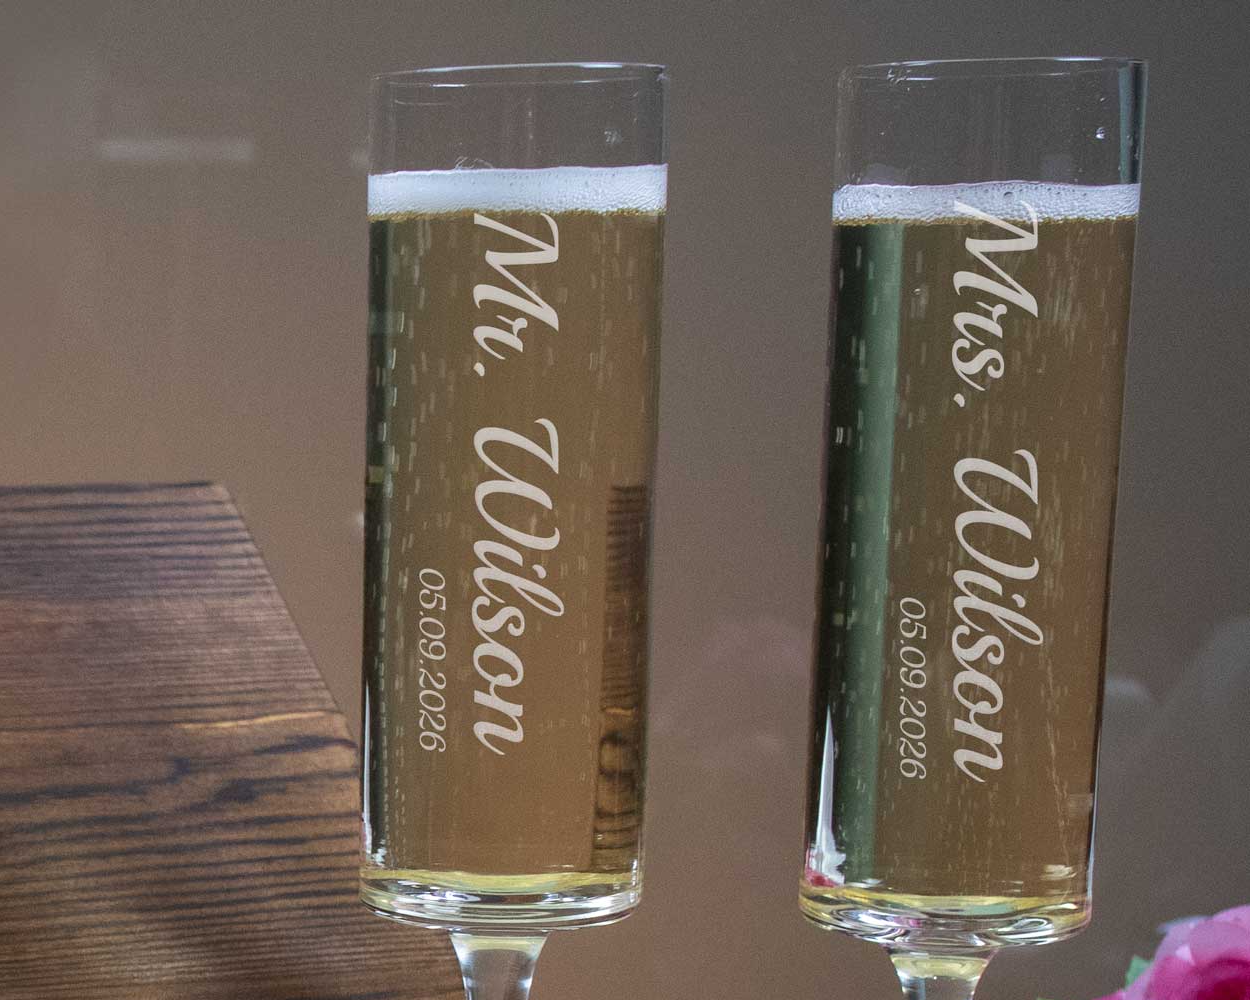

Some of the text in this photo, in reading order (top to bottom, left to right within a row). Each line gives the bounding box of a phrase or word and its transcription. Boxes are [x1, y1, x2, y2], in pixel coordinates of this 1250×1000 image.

[419, 567, 447, 754] 05.09.2026
[471, 212, 565, 757] Mr. Wilson
[952, 199, 1044, 783] Mrs. Wilson
[899, 597, 927, 781] 05.09.2026
